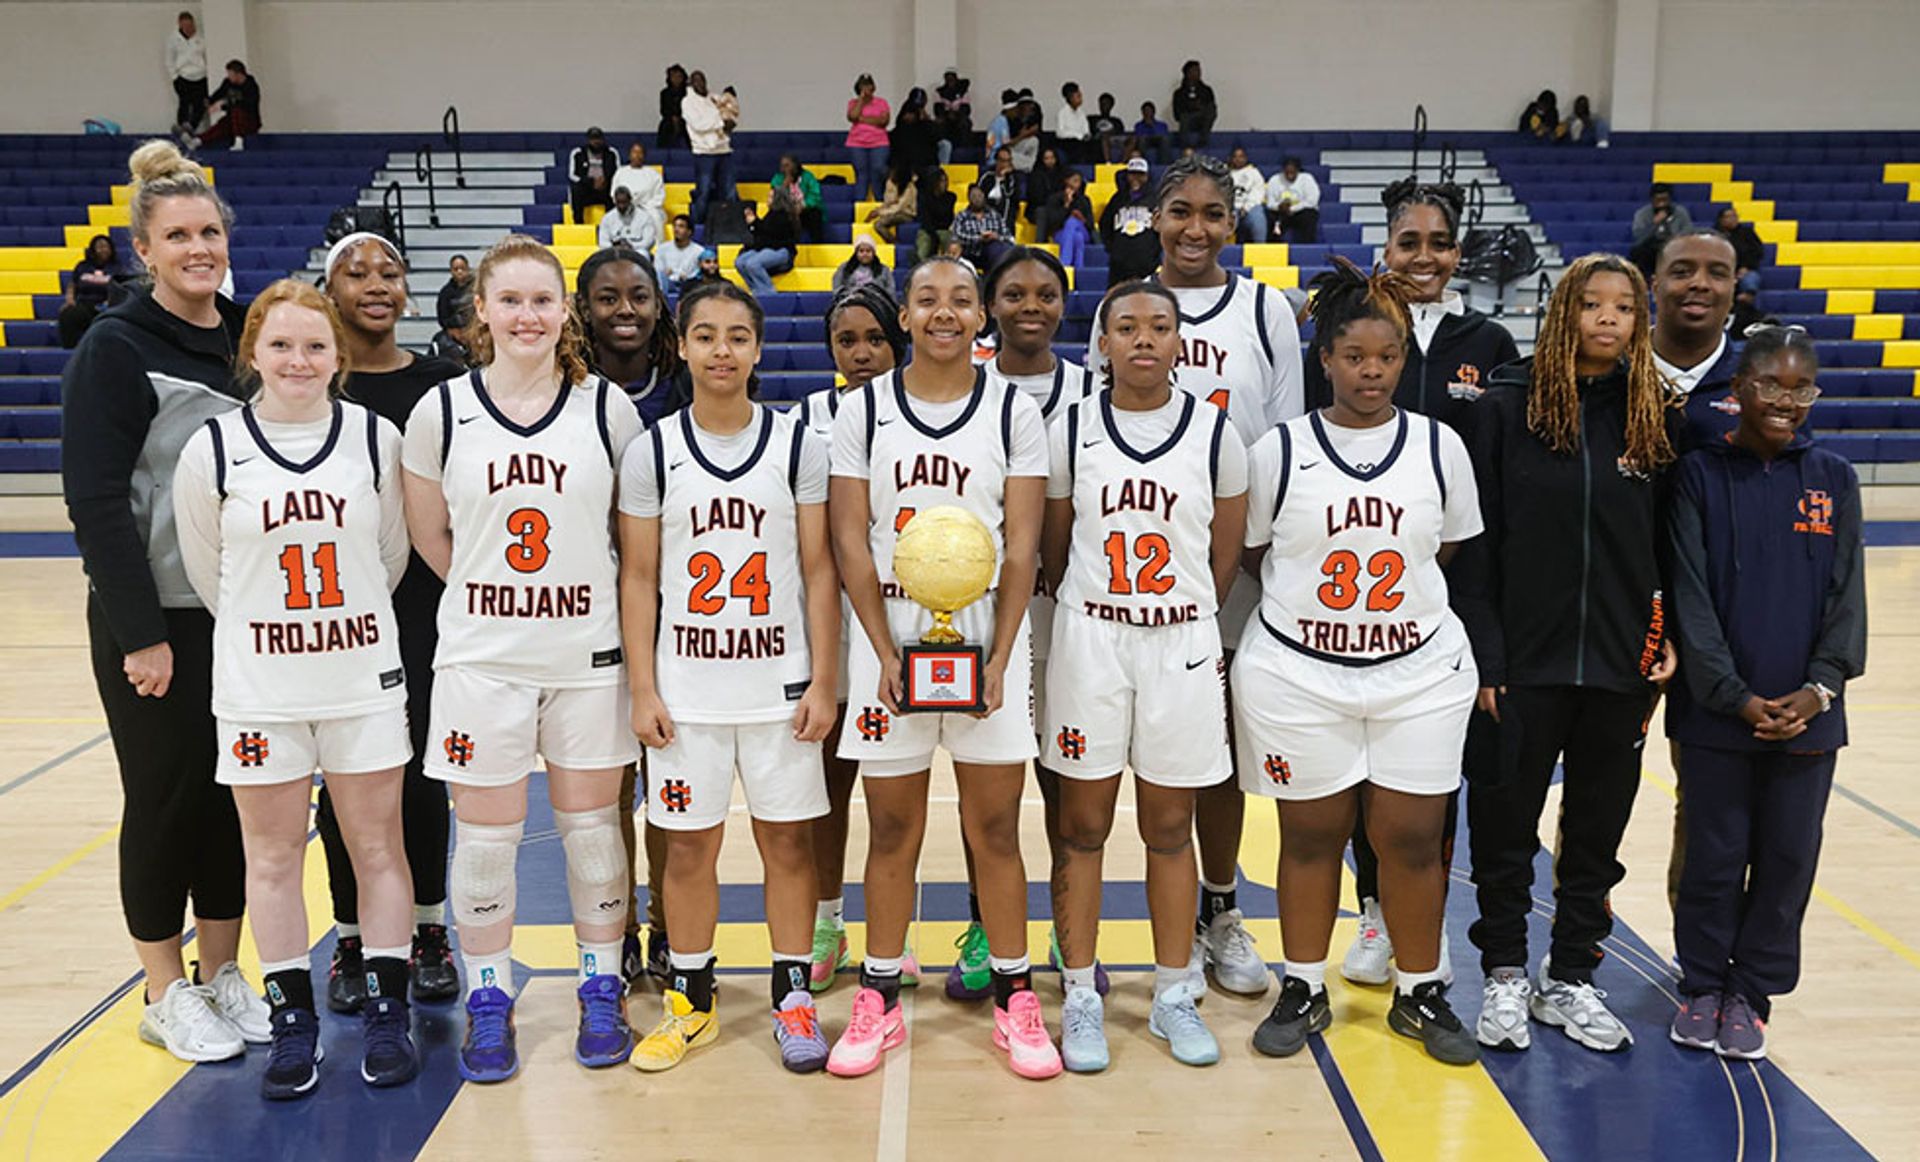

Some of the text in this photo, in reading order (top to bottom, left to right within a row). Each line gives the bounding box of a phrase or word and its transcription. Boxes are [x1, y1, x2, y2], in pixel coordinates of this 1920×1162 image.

[1174, 338, 1228, 376] ADY
[485, 453, 568, 496] LADY
[894, 453, 971, 496] LADY
[262, 490, 347, 534] LADY
[690, 497, 767, 539] LADY
[1101, 478, 1179, 522] LADY
[1326, 496, 1405, 538] LADY
[504, 507, 552, 574] 3
[278, 541, 345, 611] 11
[687, 551, 771, 617] 24
[1103, 531, 1176, 596] 12
[1317, 549, 1407, 613] 32
[465, 582, 592, 619] TROJANS
[249, 612, 380, 655] TROJANS
[673, 624, 786, 660] TROJANS
[1297, 618, 1421, 653] TROJANS
